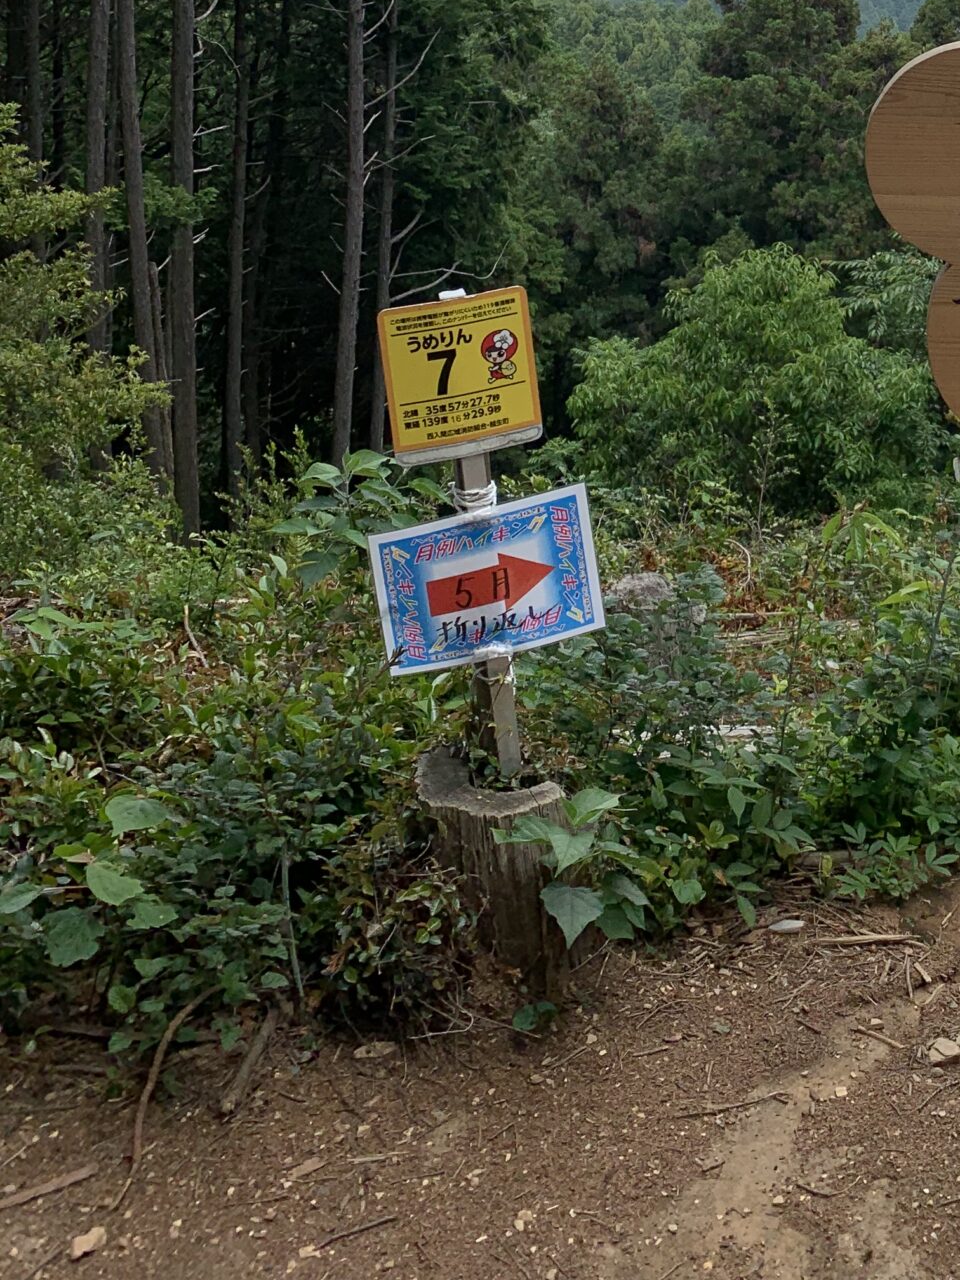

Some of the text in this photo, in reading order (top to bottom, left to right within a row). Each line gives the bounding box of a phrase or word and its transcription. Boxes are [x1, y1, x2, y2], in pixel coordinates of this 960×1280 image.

[406, 328, 473, 353] うめりん
[426, 349, 457, 396] 7
[454, 567, 510, 609] 5月
